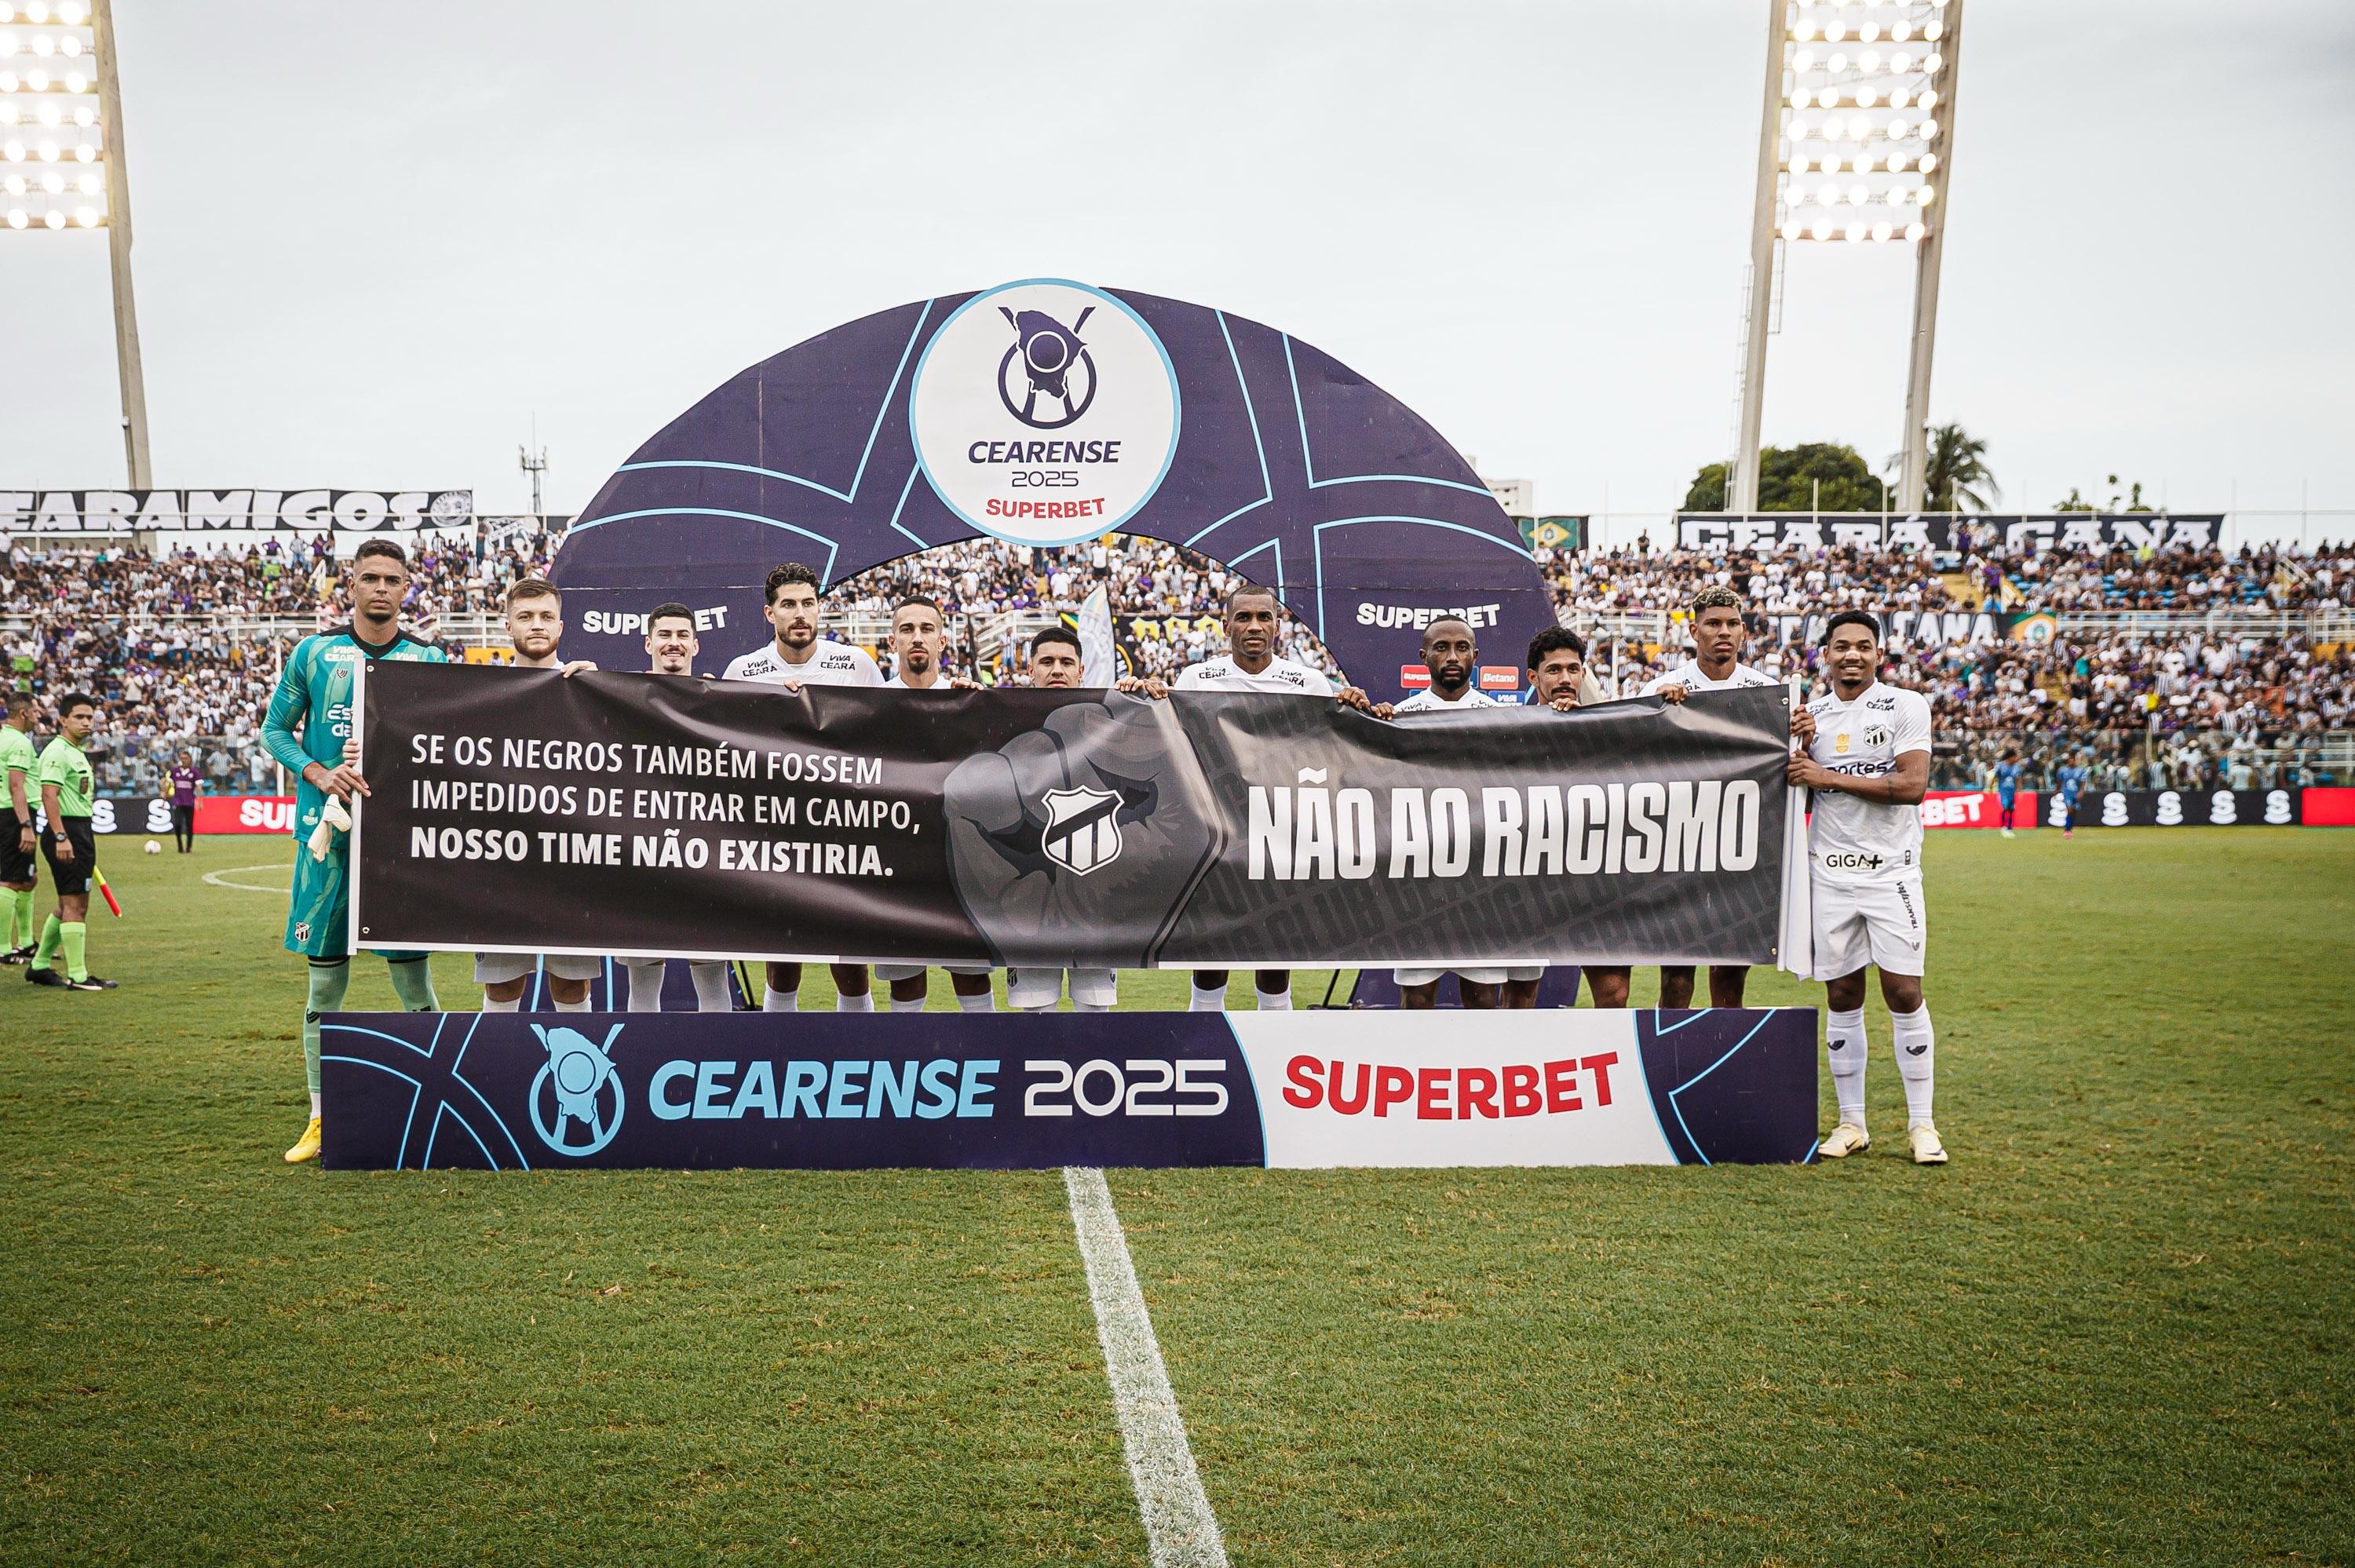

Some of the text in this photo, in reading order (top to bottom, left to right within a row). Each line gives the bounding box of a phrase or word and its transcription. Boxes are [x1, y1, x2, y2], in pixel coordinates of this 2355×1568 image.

[968, 440, 1121, 463] CEARENSE
[1011, 471, 1079, 487] 2025
[986, 498, 1105, 519] SUPERBET
[582, 605, 728, 635] SUPET
[324, 653, 356, 662] CEAR
[747, 659, 769, 668] VIVA
[820, 661, 856, 671] CEARÁ
[743, 664, 777, 677] CEARÁ
[1199, 669, 1231, 679] CEAR
[1483, 673, 1516, 683] Betano
[411, 734, 882, 785] SE OS NEGROS TAMBÉM FOSSEM
[412, 779, 920, 834] IMPEDIDOS DE ENTRAR EM CAMPO,
[1922, 793, 1984, 826] BET
[1248, 766, 1760, 881] NÃO AO RACISMO
[411, 826, 893, 876] NOSSO TIME NÃO EXISTIRIA.
[1827, 855, 1883, 870] GIGA+
[648, 1059, 1226, 1121] CEARENSE 2025
[1282, 1050, 1619, 1120] SUPERBET
